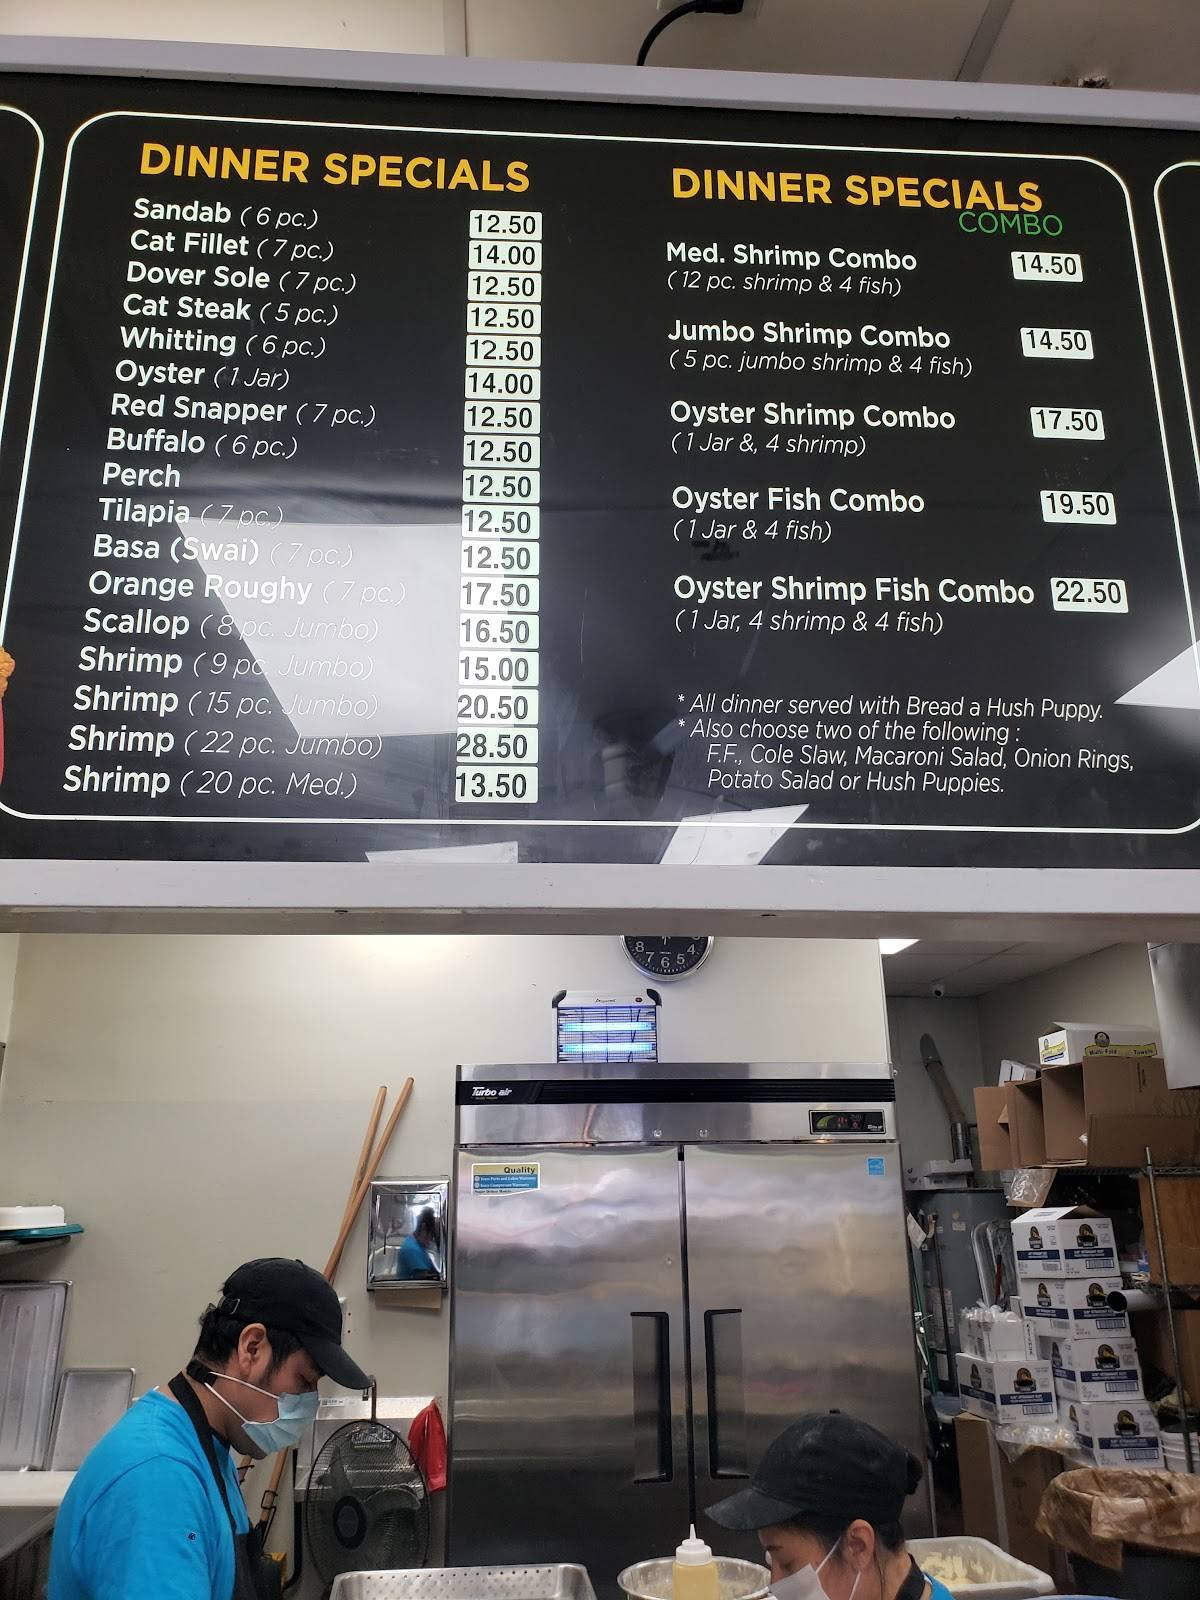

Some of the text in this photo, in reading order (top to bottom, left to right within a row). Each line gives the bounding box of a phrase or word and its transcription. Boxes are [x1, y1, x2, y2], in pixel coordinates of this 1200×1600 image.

[141, 143, 529, 192] DINNER SPECIALS
[673, 168, 1042, 212] DINNER SPECIALS
[134, 198, 317, 229] Sandab pc.)
[475, 214, 535, 234] 12.50
[959, 212, 1062, 235] COMBO
[131, 229, 333, 261] Cat Fillet pc.)
[474, 245, 535, 265] 14.00
[667, 242, 916, 270] Med. Shrimp Combo
[127, 261, 355, 294] Dover Sole pc.)
[1018, 255, 1076, 275] 14.50
[473, 276, 534, 296] 12.50
[707, 276, 735, 291] pc.
[743, 273, 812, 294] shrimp
[819, 276, 832, 292] &
[839, 277, 851, 292] 4
[860, 277, 901, 297] fish)
[124, 294, 338, 326] Cat Steak pc.)
[472, 307, 534, 328] 12.50
[121, 326, 325, 358] Whitting pc.)
[668, 320, 950, 348] Jumbo Shrimp Combo
[1027, 330, 1086, 350] 14.50
[470, 340, 533, 361] 12.50
[116, 360, 205, 386] Oyster
[244, 368, 289, 390] Jar)
[703, 355, 731, 371] pc.
[738, 351, 805, 372] jumbo
[812, 353, 881, 375] shrimp
[889, 355, 902, 372] &
[909, 357, 922, 373] 4
[930, 356, 972, 377] fish)
[469, 373, 532, 394] 14.00
[112, 393, 375, 427] Red Snapper pc.)
[468, 406, 532, 428] 12.50
[671, 401, 955, 430] Oyster Shrimp Combo
[1036, 410, 1097, 431] 17.50
[107, 428, 297, 459] Buffalo pc.)
[467, 440, 531, 462] 12.50
[700, 433, 734, 451] Jar
[740, 434, 757, 454] &,
[766, 434, 779, 452] 4
[786, 434, 865, 457] shrimp)
[103, 463, 180, 487] Perch
[466, 475, 531, 497] 12.50
[673, 486, 924, 513] Oyster Fish Combo
[1046, 493, 1109, 515] 19.50
[99, 497, 283, 528] Tilapia pc.)
[465, 510, 530, 533] 12.50
[702, 520, 736, 539] Jar
[743, 520, 757, 539] &
[765, 520, 778, 539] 4
[786, 520, 831, 543] fish)
[94, 534, 159, 559] Basa
[171, 537, 259, 566] (Swai)
[462, 546, 531, 570] 12.50
[89, 571, 194, 601] Orange
[204, 574, 312, 605] Roughy
[461, 581, 530, 606] 17.50
[674, 575, 1034, 605] Oyster Shrimp Fish Combo
[1056, 581, 1121, 603] 22.50
[83, 608, 189, 639] Scallop
[283, 616, 379, 641] Jumbo)
[460, 619, 529, 643] 16.50
[704, 610, 739, 632] Jar,
[749, 610, 762, 630] 4
[770, 610, 845, 634] shrimp
[853, 611, 867, 631] &
[875, 612, 888, 631] 4
[897, 611, 942, 635] fish)
[79, 646, 182, 678] Shrimp
[279, 653, 374, 679] Jumbo)
[459, 656, 529, 681] 15.00
[73, 685, 378, 718] Shrimp pc. Jumbo)
[458, 696, 527, 719] 20.50
[690, 693, 1102, 722] All dinner served with Bread a Hush Puppy.
[68, 724, 382, 759] Shrimp pc. Jumbo)
[690, 718, 1009, 745] Also choose two of the following
[456, 734, 527, 759] 28.50
[751, 744, 793, 763] Cole
[800, 745, 846, 766] Slaw,
[855, 746, 944, 765] Macaroni
[950, 747, 1006, 769] Salad,
[1015, 748, 1070, 767] Onion
[1078, 749, 1133, 772] Rings,
[63, 765, 356, 799] Shrimp pc. Med.)
[456, 773, 527, 798] 13.50
[708, 769, 1003, 795] Potato Salad or Hush Puppies.
[636, 941, 644, 952] 8
[646, 952, 654, 963] 7
[676, 954, 685, 964] 5
[687, 944, 696, 955] 4
[661, 957, 670, 968] 6
[472, 1086, 497, 1096] Turbo
[504, 1166, 536, 1174] Quality
